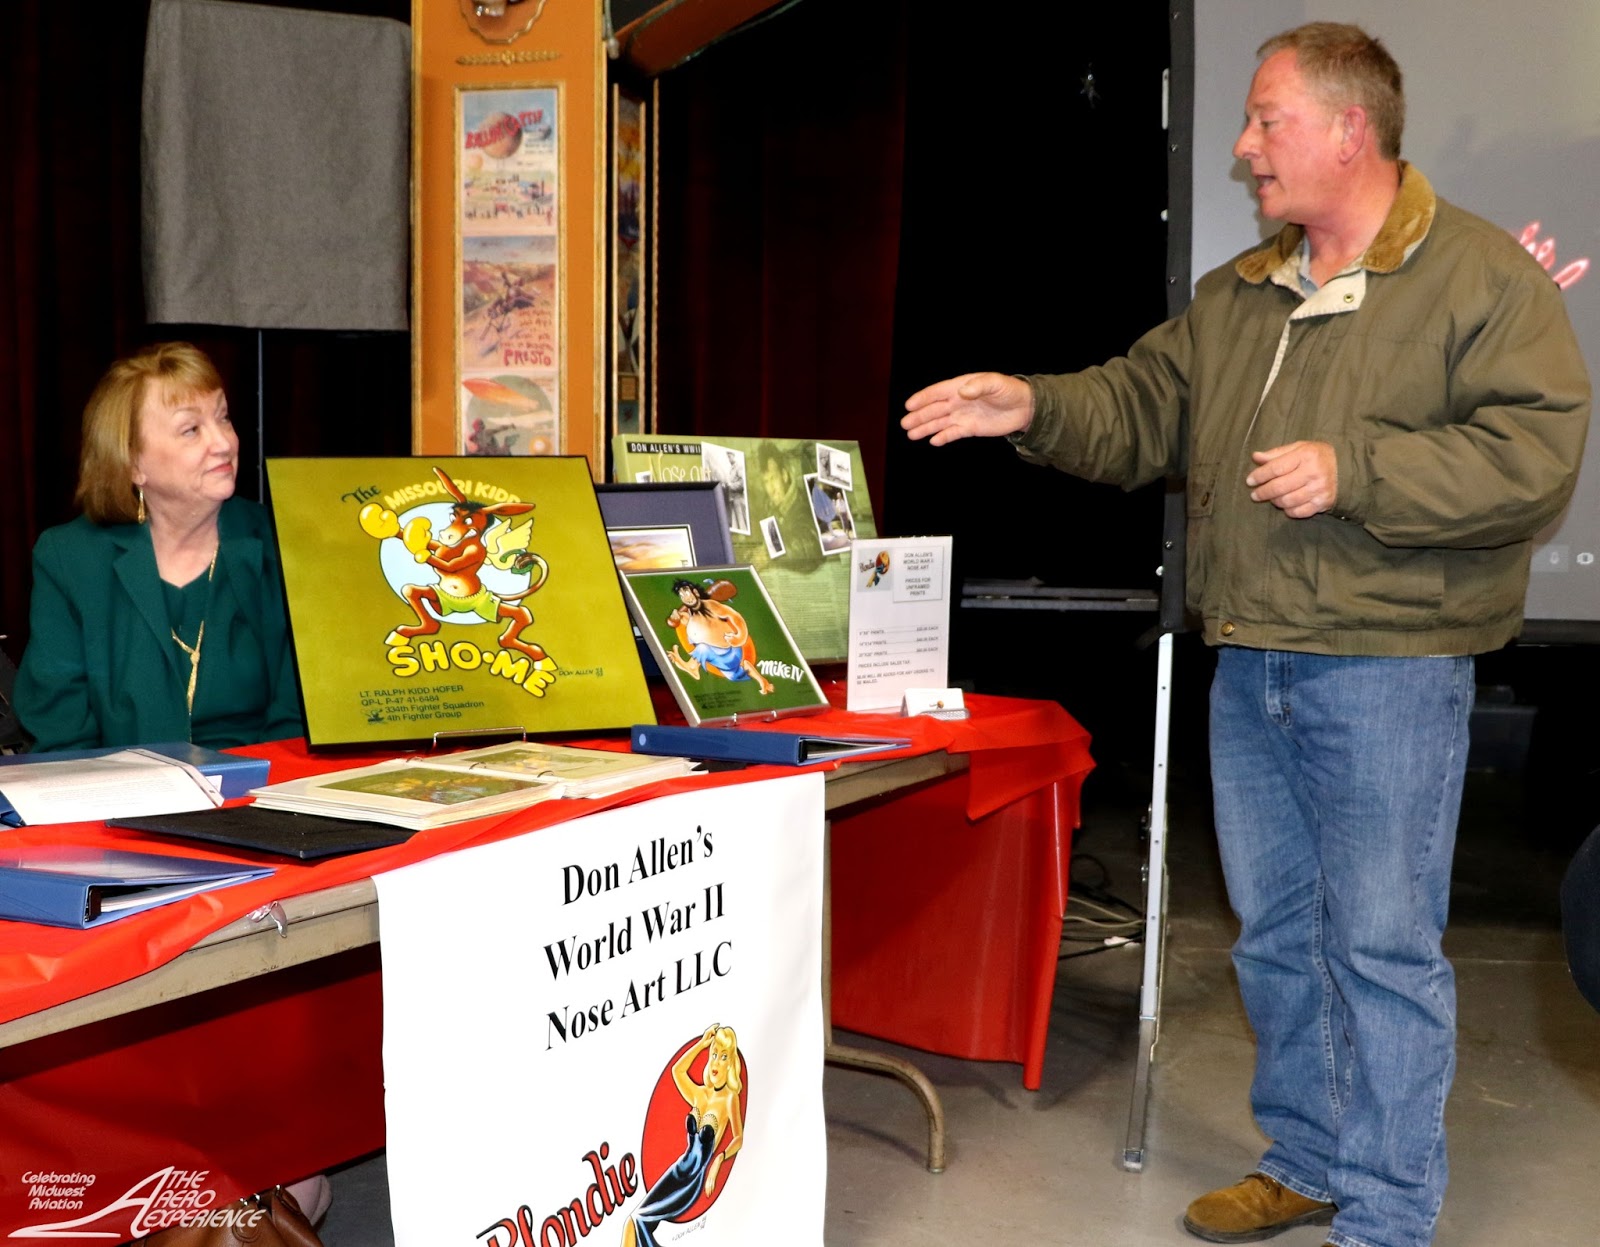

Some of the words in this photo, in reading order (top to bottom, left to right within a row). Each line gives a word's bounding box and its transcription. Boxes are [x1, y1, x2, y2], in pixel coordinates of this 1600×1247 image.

[631, 443, 648, 452] DON
[649, 443, 681, 453] ALLEN'S
[341, 484, 382, 506] The
[374, 688, 406, 697] RALPH
[408, 686, 430, 695] KIDD
[432, 684, 464, 693] HOFER
[387, 713, 401, 721] 4th
[403, 711, 432, 722] Fighter
[435, 710, 462, 721] Group
[411, 702, 440, 714] Fighter
[443, 701, 484, 711] Squadron
[561, 862, 620, 906] Don
[628, 825, 714, 884] Allen's
[543, 915, 633, 982] World
[641, 901, 696, 944] War
[702, 882, 725, 923] II
[545, 998, 614, 1051] Nose
[620, 969, 667, 1020] Art
[673, 939, 732, 996] LLC
